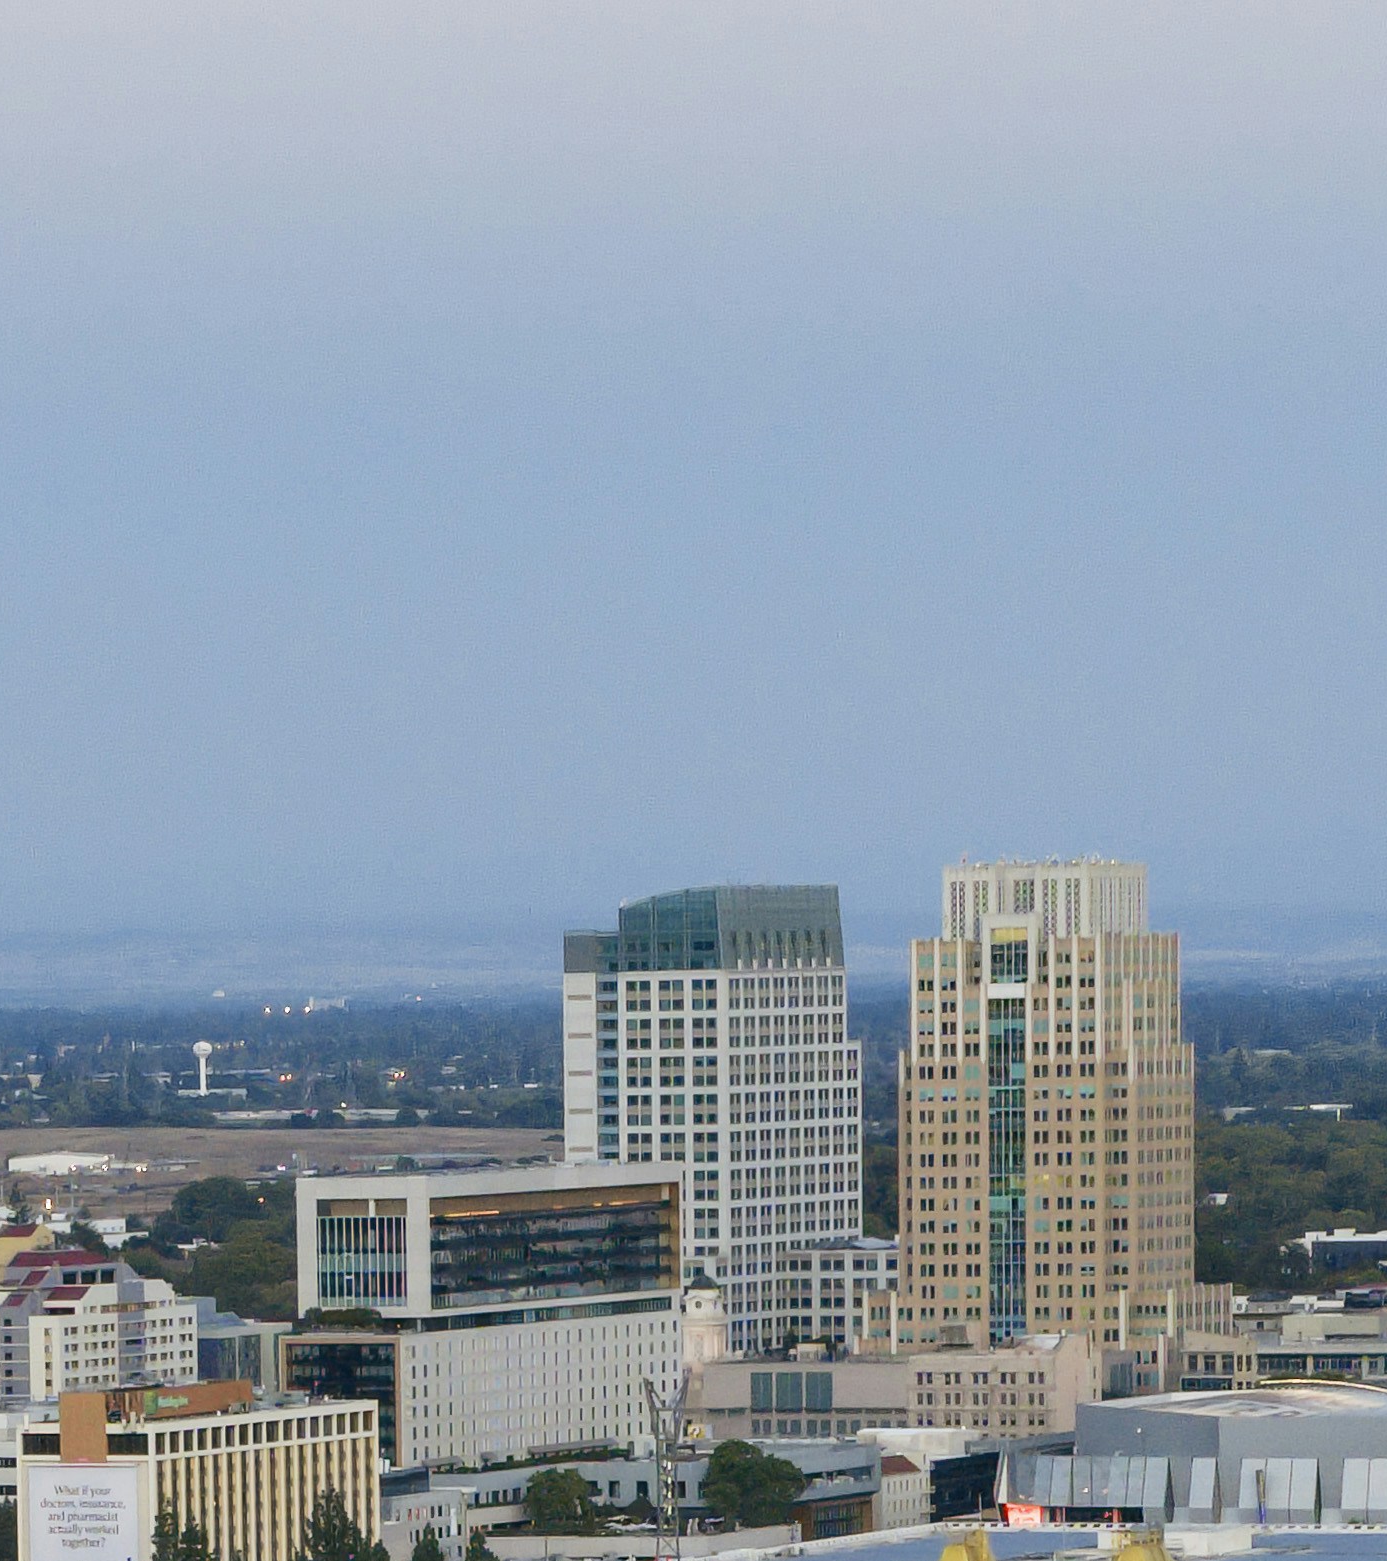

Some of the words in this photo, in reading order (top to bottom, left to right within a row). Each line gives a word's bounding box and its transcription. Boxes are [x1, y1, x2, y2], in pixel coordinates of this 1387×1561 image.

[54, 1485, 79, 1495] What
[90, 1487, 111, 1498] your
[48, 1511, 65, 1521] and
